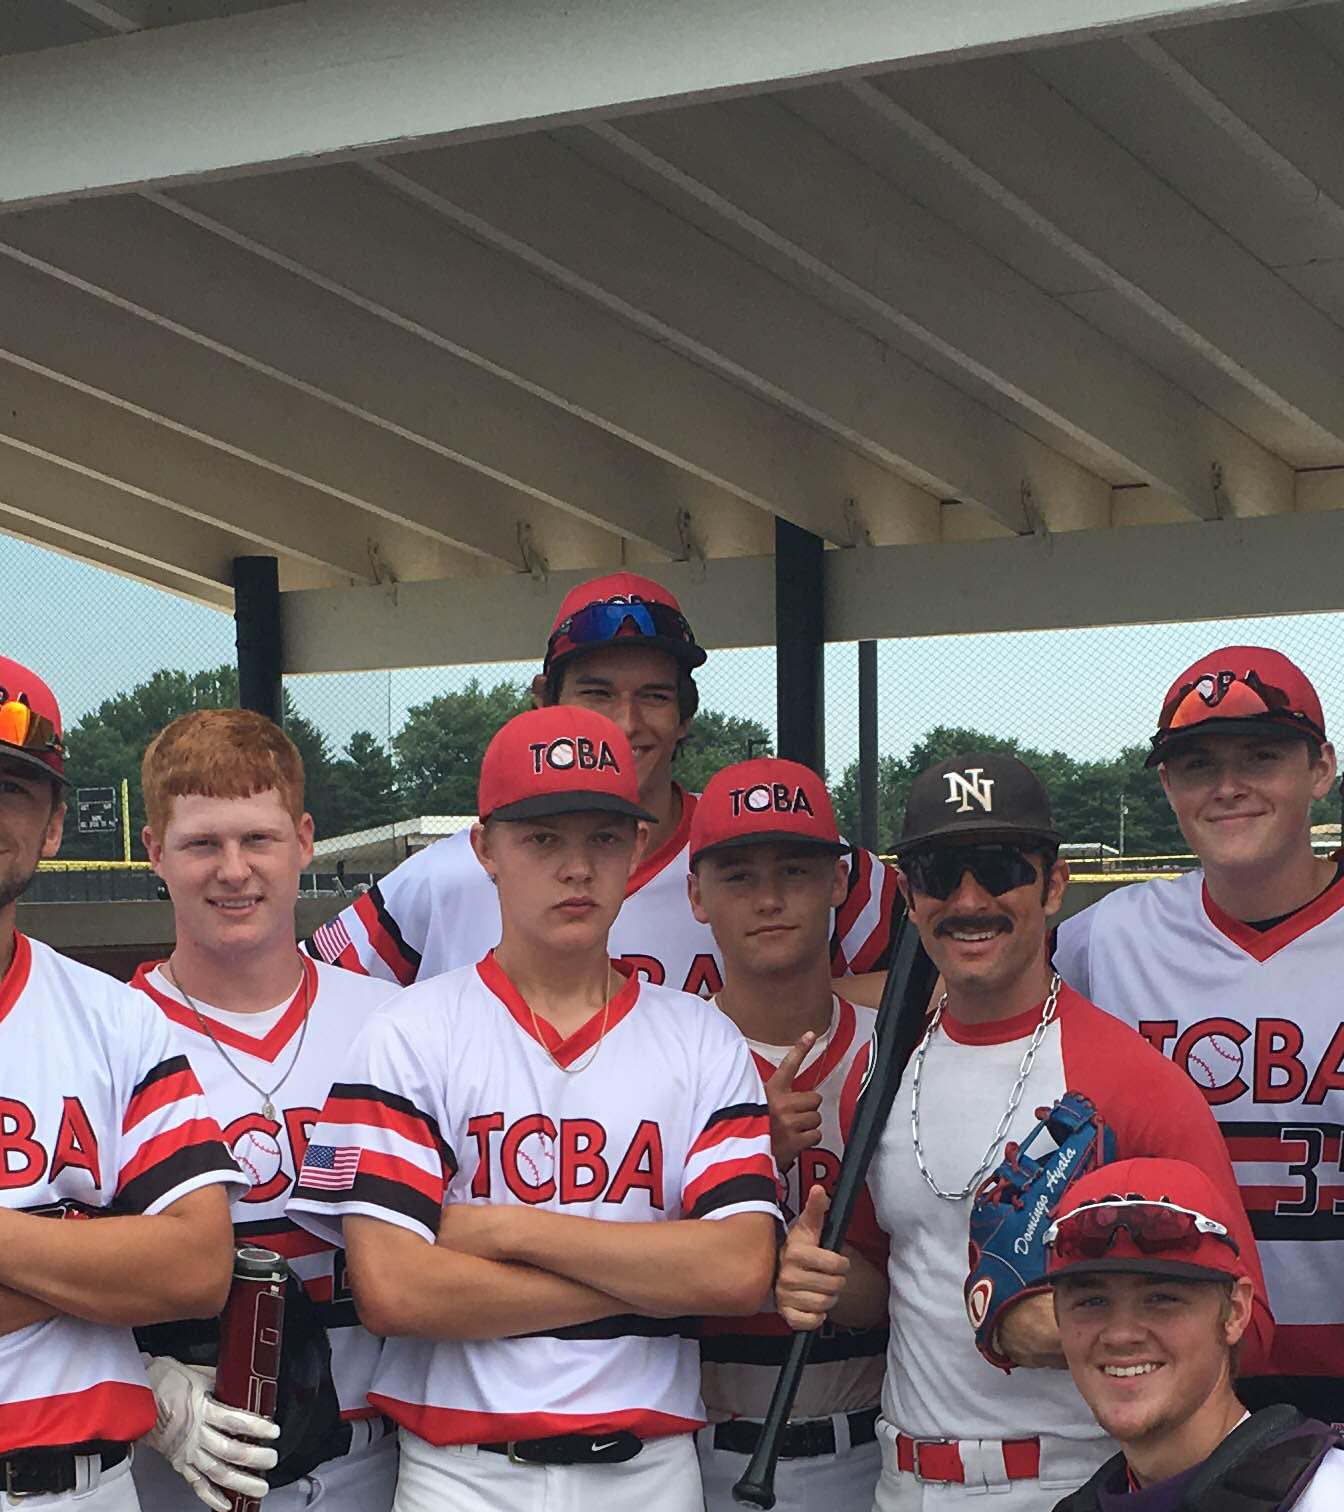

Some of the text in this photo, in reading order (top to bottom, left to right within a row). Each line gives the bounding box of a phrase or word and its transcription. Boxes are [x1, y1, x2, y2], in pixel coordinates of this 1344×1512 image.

[528, 736, 622, 776] TCBA
[728, 782, 816, 818] TCBA
[467, 1112, 665, 1210] TCBA
[1014, 1147, 1077, 1256] Domingo Ayala
